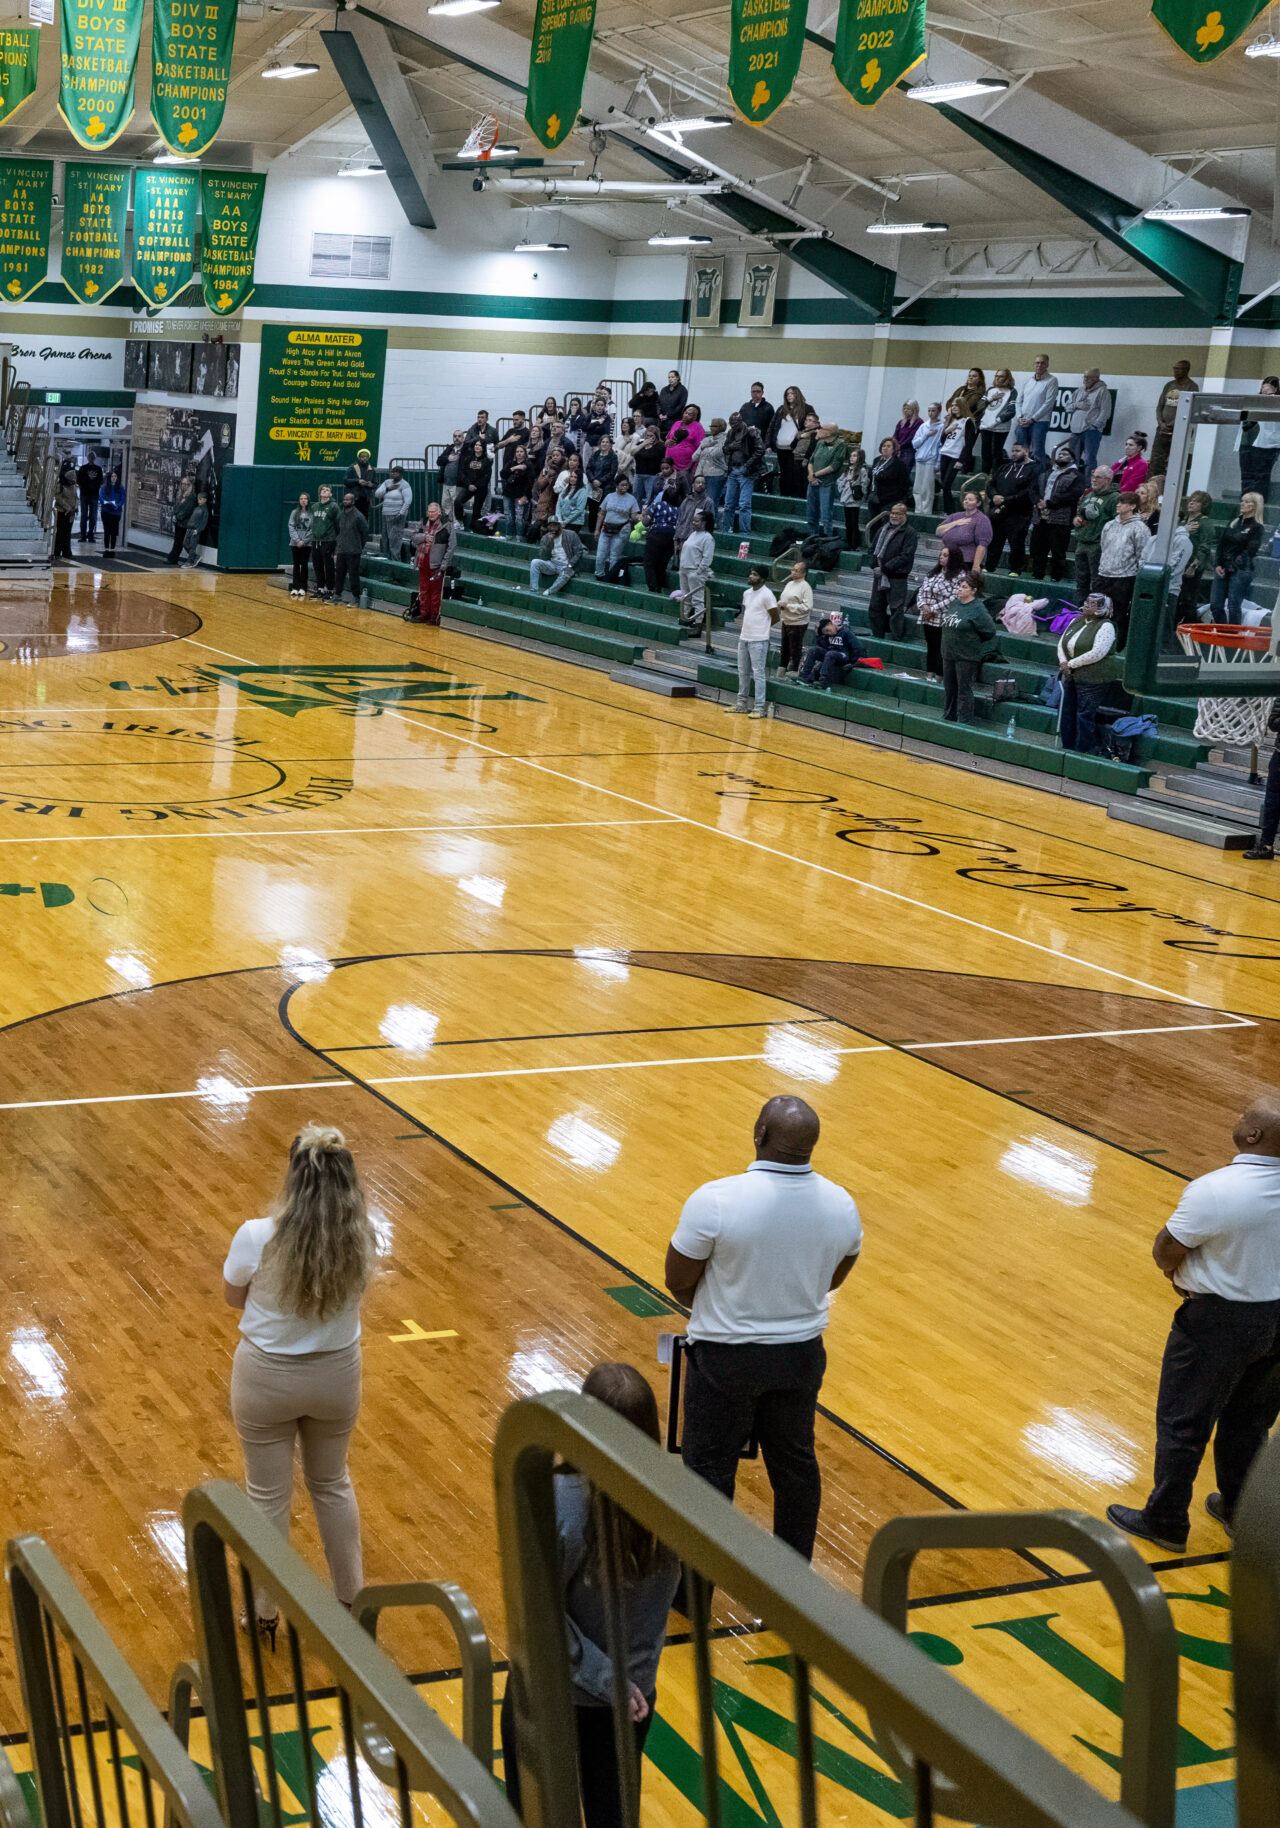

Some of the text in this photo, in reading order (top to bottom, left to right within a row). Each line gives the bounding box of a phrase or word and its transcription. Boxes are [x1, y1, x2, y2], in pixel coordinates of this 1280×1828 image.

[78, 0, 105, 10] DIV
[171, 2, 219, 20] DIV III
[857, 0, 909, 20] CHAMPIONS
[78, 15, 125, 33] BOYS
[740, 17, 788, 43] CHAMPIONS
[171, 23, 217, 40] BOYS
[75, 35, 126, 54] STATE
[858, 30, 894, 51] 2022
[168, 43, 217, 61] STATE
[62, 53, 130, 74] BASKETBAL
[749, 51, 778, 71] 2021
[155, 61, 228, 81] BASKETBALL
[64, 75, 126, 94] CHAMPION
[157, 82, 225, 102] CHAMPIONS
[77, 98, 115, 113] 2000
[172, 105, 206, 120] 2001
[221, 180, 258, 190] VINCENT
[13, 189, 27, 199] AA
[90, 192, 104, 203] AA
[227, 191, 251, 200] MARY
[5, 200, 34, 211] BOYS
[156, 197, 178, 208] AAA
[83, 203, 111, 215] BOYS
[149, 209, 184, 220] GIRLS
[221, 205, 241, 216] AA
[1, 212, 36, 224] STATE
[79, 217, 112, 229] STATE
[148, 222, 183, 234] STATE
[212, 219, 247, 232] BOYS
[70, 232, 118, 243] FOOTBALL
[139, 236, 190, 247] SOFTBALL
[211, 234, 248, 247] STATE
[66, 247, 121, 259] CHAMPIONS
[137, 250, 192, 262] CHAMPIONS
[203, 247, 255, 261] BASKETBALL
[4, 262, 28, 272] 1981
[80, 263, 104, 274] 1982
[203, 263, 252, 276] CHAMPIONS
[213, 280, 239, 290] 1984
[754, 279, 768, 297] 21
[129, 320, 133, 333] I
[133, 320, 164, 334] PROMISE
[296, 333, 355, 343] ALMA MATER
[39, 347, 76, 361] James
[78, 348, 112, 360] Arena
[286, 348, 300, 356] High
[282, 358, 301, 366] Waves
[303, 358, 315, 366] The
[316, 359, 335, 367] Green
[350, 360, 365, 368] Gold
[283, 378, 360, 389] Courage Strong And Bold
[64, 416, 120, 428] FOREVER
[287, 430, 313, 438] VINCENT
[315, 431, 324, 439] ST.
[327, 431, 343, 439] MARY
[696, 770, 839, 804] Court
[821, 804, 1018, 857] Joyce
